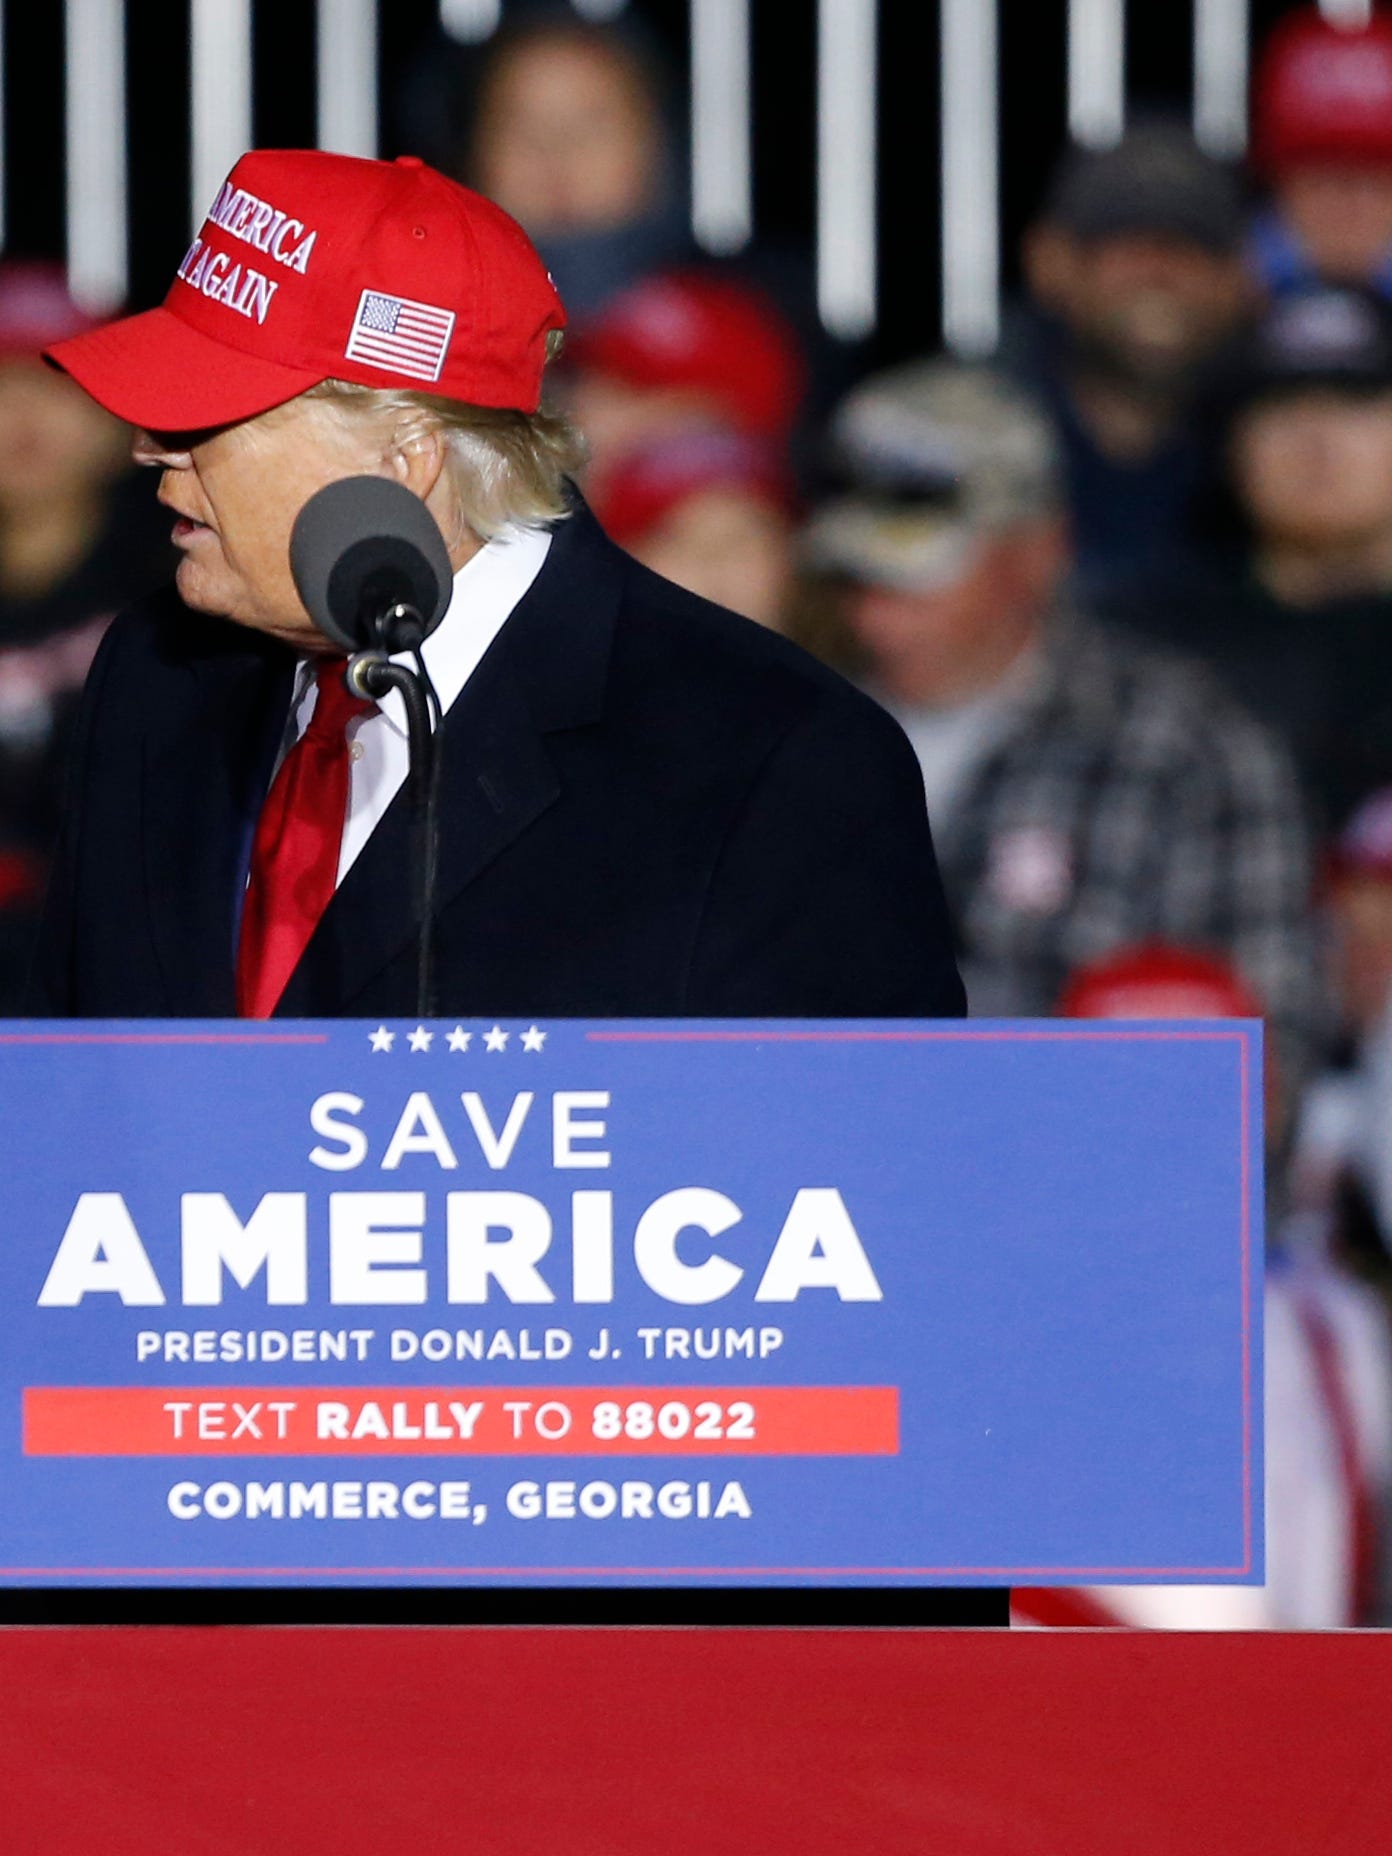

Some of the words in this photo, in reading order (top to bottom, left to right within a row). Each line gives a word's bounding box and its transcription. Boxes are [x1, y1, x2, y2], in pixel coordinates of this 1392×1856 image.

[209, 180, 317, 274] MERICA
[185, 246, 279, 325] AGAIN
[309, 1091, 611, 1171] SAVE
[37, 1187, 883, 1306] AMERICA
[138, 1330, 374, 1362] PRESIDENT
[391, 1329, 572, 1361] DONALD
[589, 1329, 621, 1360] J.
[637, 1327, 783, 1360] TRUMP
[164, 1403, 296, 1439] TEXT
[317, 1402, 484, 1439] RALLY
[503, 1402, 572, 1439] TO
[592, 1402, 756, 1439] 88022
[168, 1481, 487, 1525] COMMERCE,
[507, 1481, 752, 1519] GEORGIA
